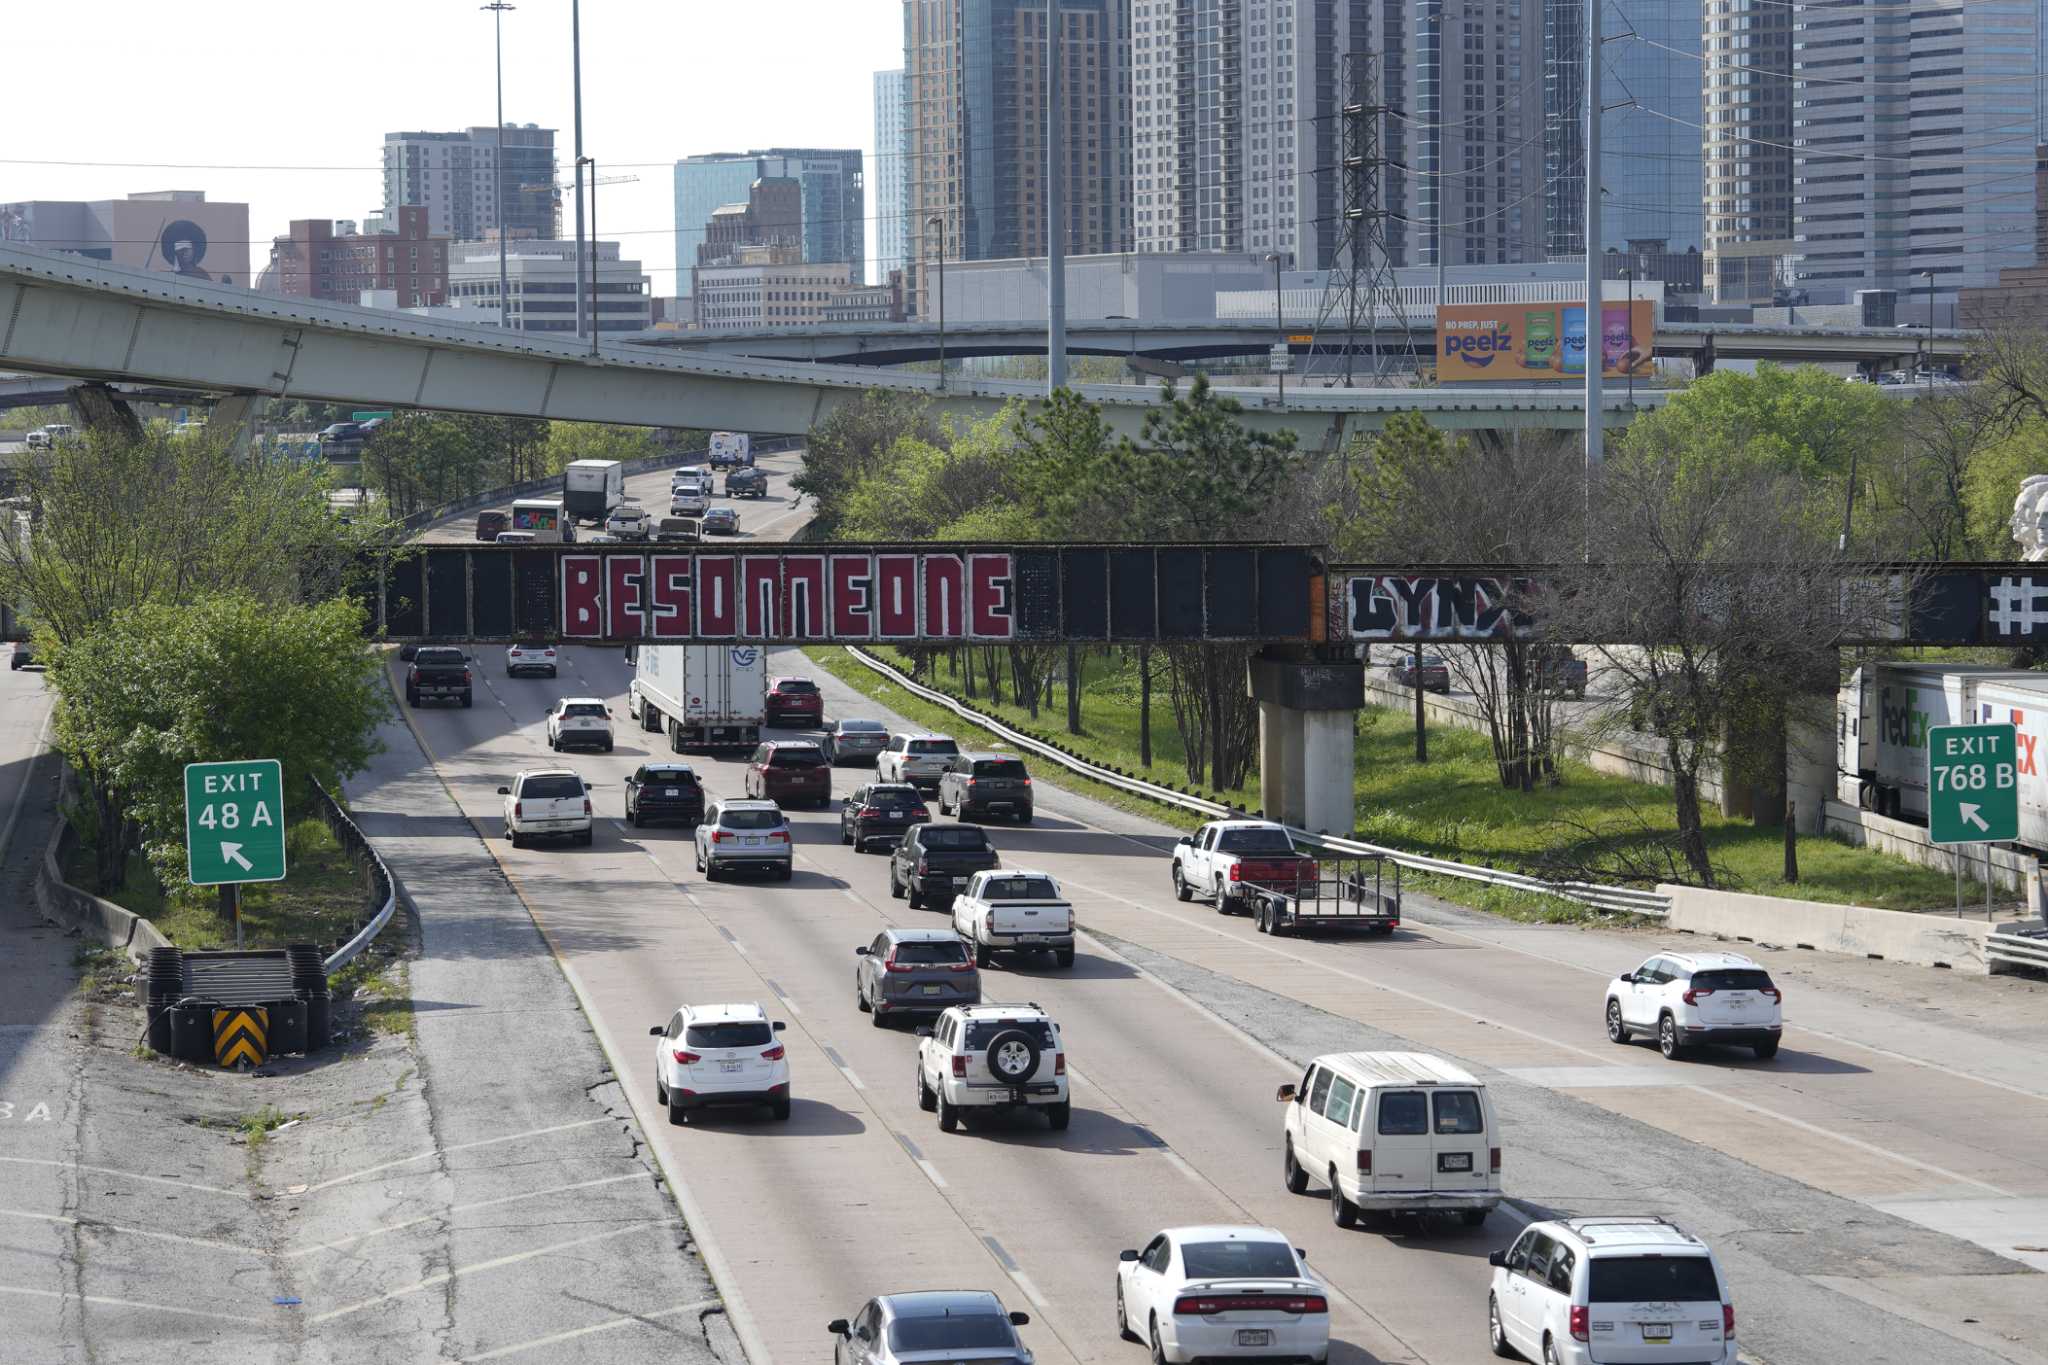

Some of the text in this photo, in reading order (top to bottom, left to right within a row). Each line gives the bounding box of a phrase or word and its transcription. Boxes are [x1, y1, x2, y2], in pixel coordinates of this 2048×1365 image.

[1444, 329, 1512, 356] peelz
[1563, 335, 1587, 347] peel
[1946, 735, 2000, 755] EXIT
[204, 773, 262, 793] EXIT
[1933, 762, 2014, 792] 768 B
[198, 800, 273, 830] 48 A
